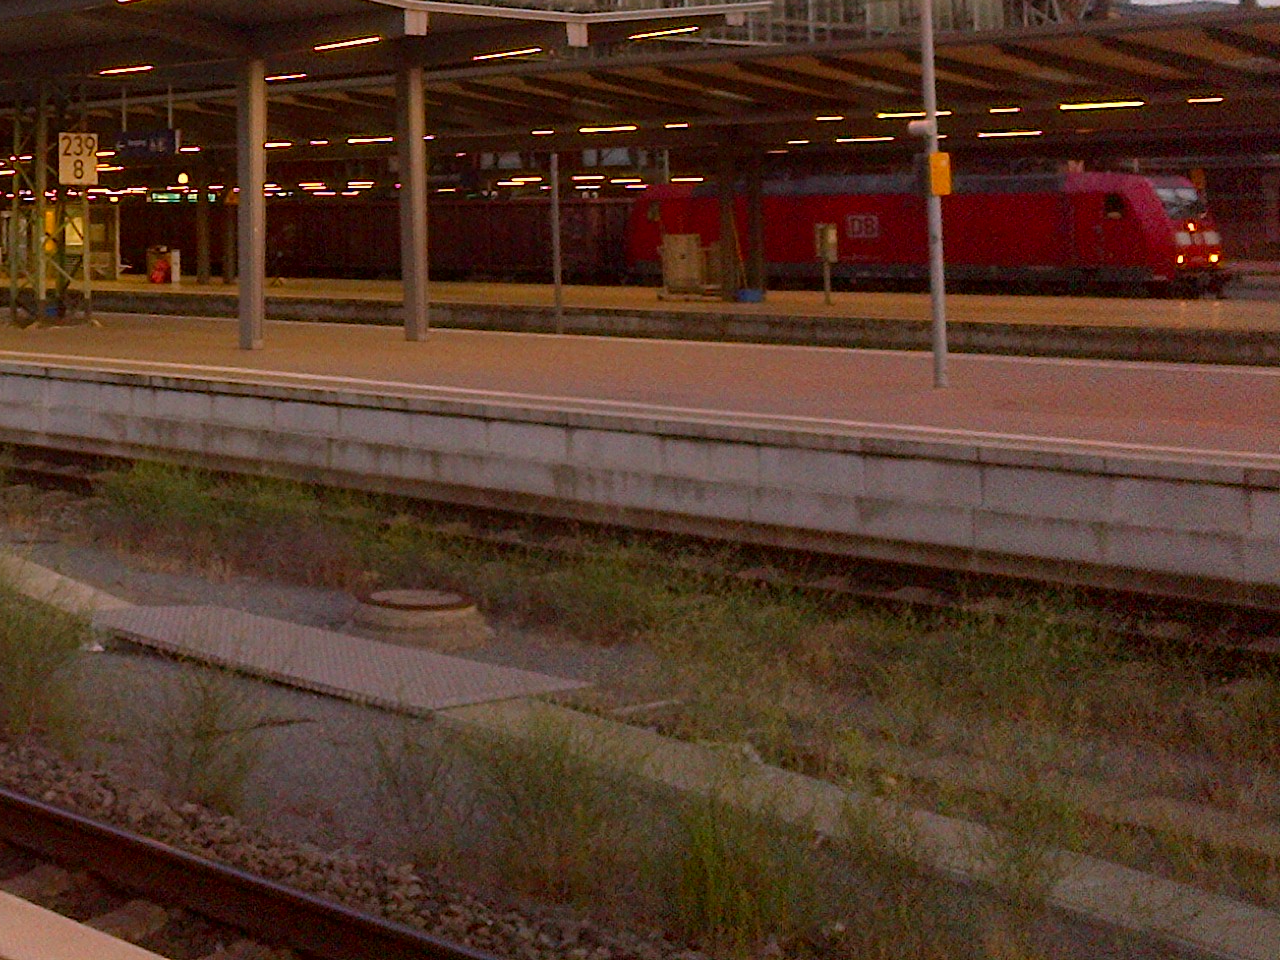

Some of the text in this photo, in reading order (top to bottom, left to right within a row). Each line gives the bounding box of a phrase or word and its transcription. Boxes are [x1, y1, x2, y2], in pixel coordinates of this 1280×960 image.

[61, 135, 96, 157] 239
[73, 159, 84, 179] 8
[849, 216, 877, 237] DB
